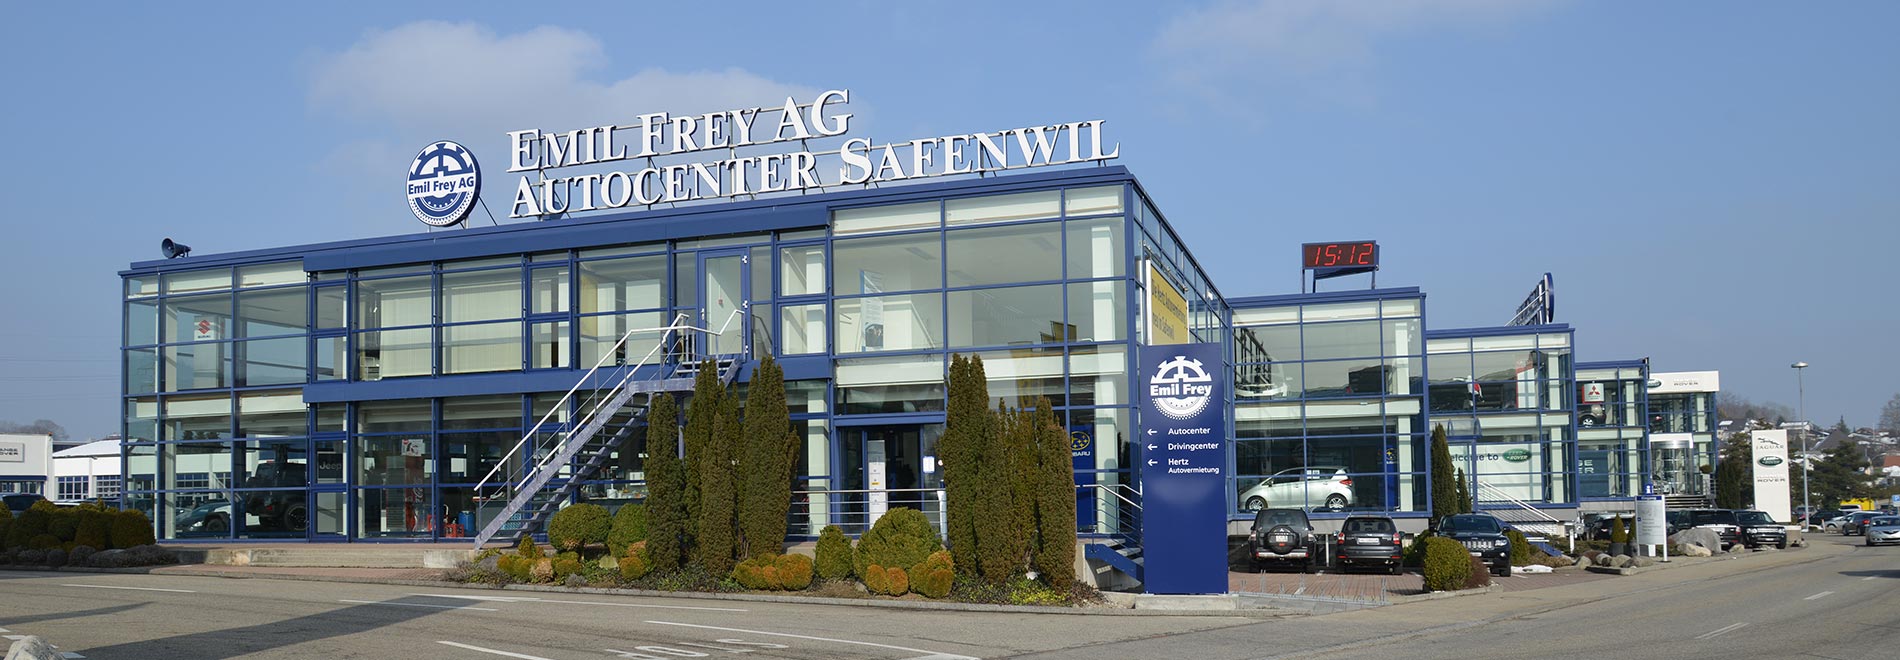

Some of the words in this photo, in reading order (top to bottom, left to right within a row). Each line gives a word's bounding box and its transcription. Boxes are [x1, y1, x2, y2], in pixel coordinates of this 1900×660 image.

[506, 125, 627, 172] EMIL
[636, 107, 761, 158] FREY
[774, 88, 853, 142] AG
[508, 151, 818, 218] AUTOCENTER
[840, 119, 1120, 185] SAFENWIL
[408, 181, 430, 195] Emil
[433, 180, 456, 192] Frey
[459, 176, 474, 188] AG
[1315, 243, 1373, 266] 15:12
[1150, 383, 1179, 396] Emil
[1183, 383, 1212, 397] Frey
[1168, 443, 1219, 451] Drivingcenter
[1487, 453, 1499, 461] to
[320, 461, 342, 470] Jeep
